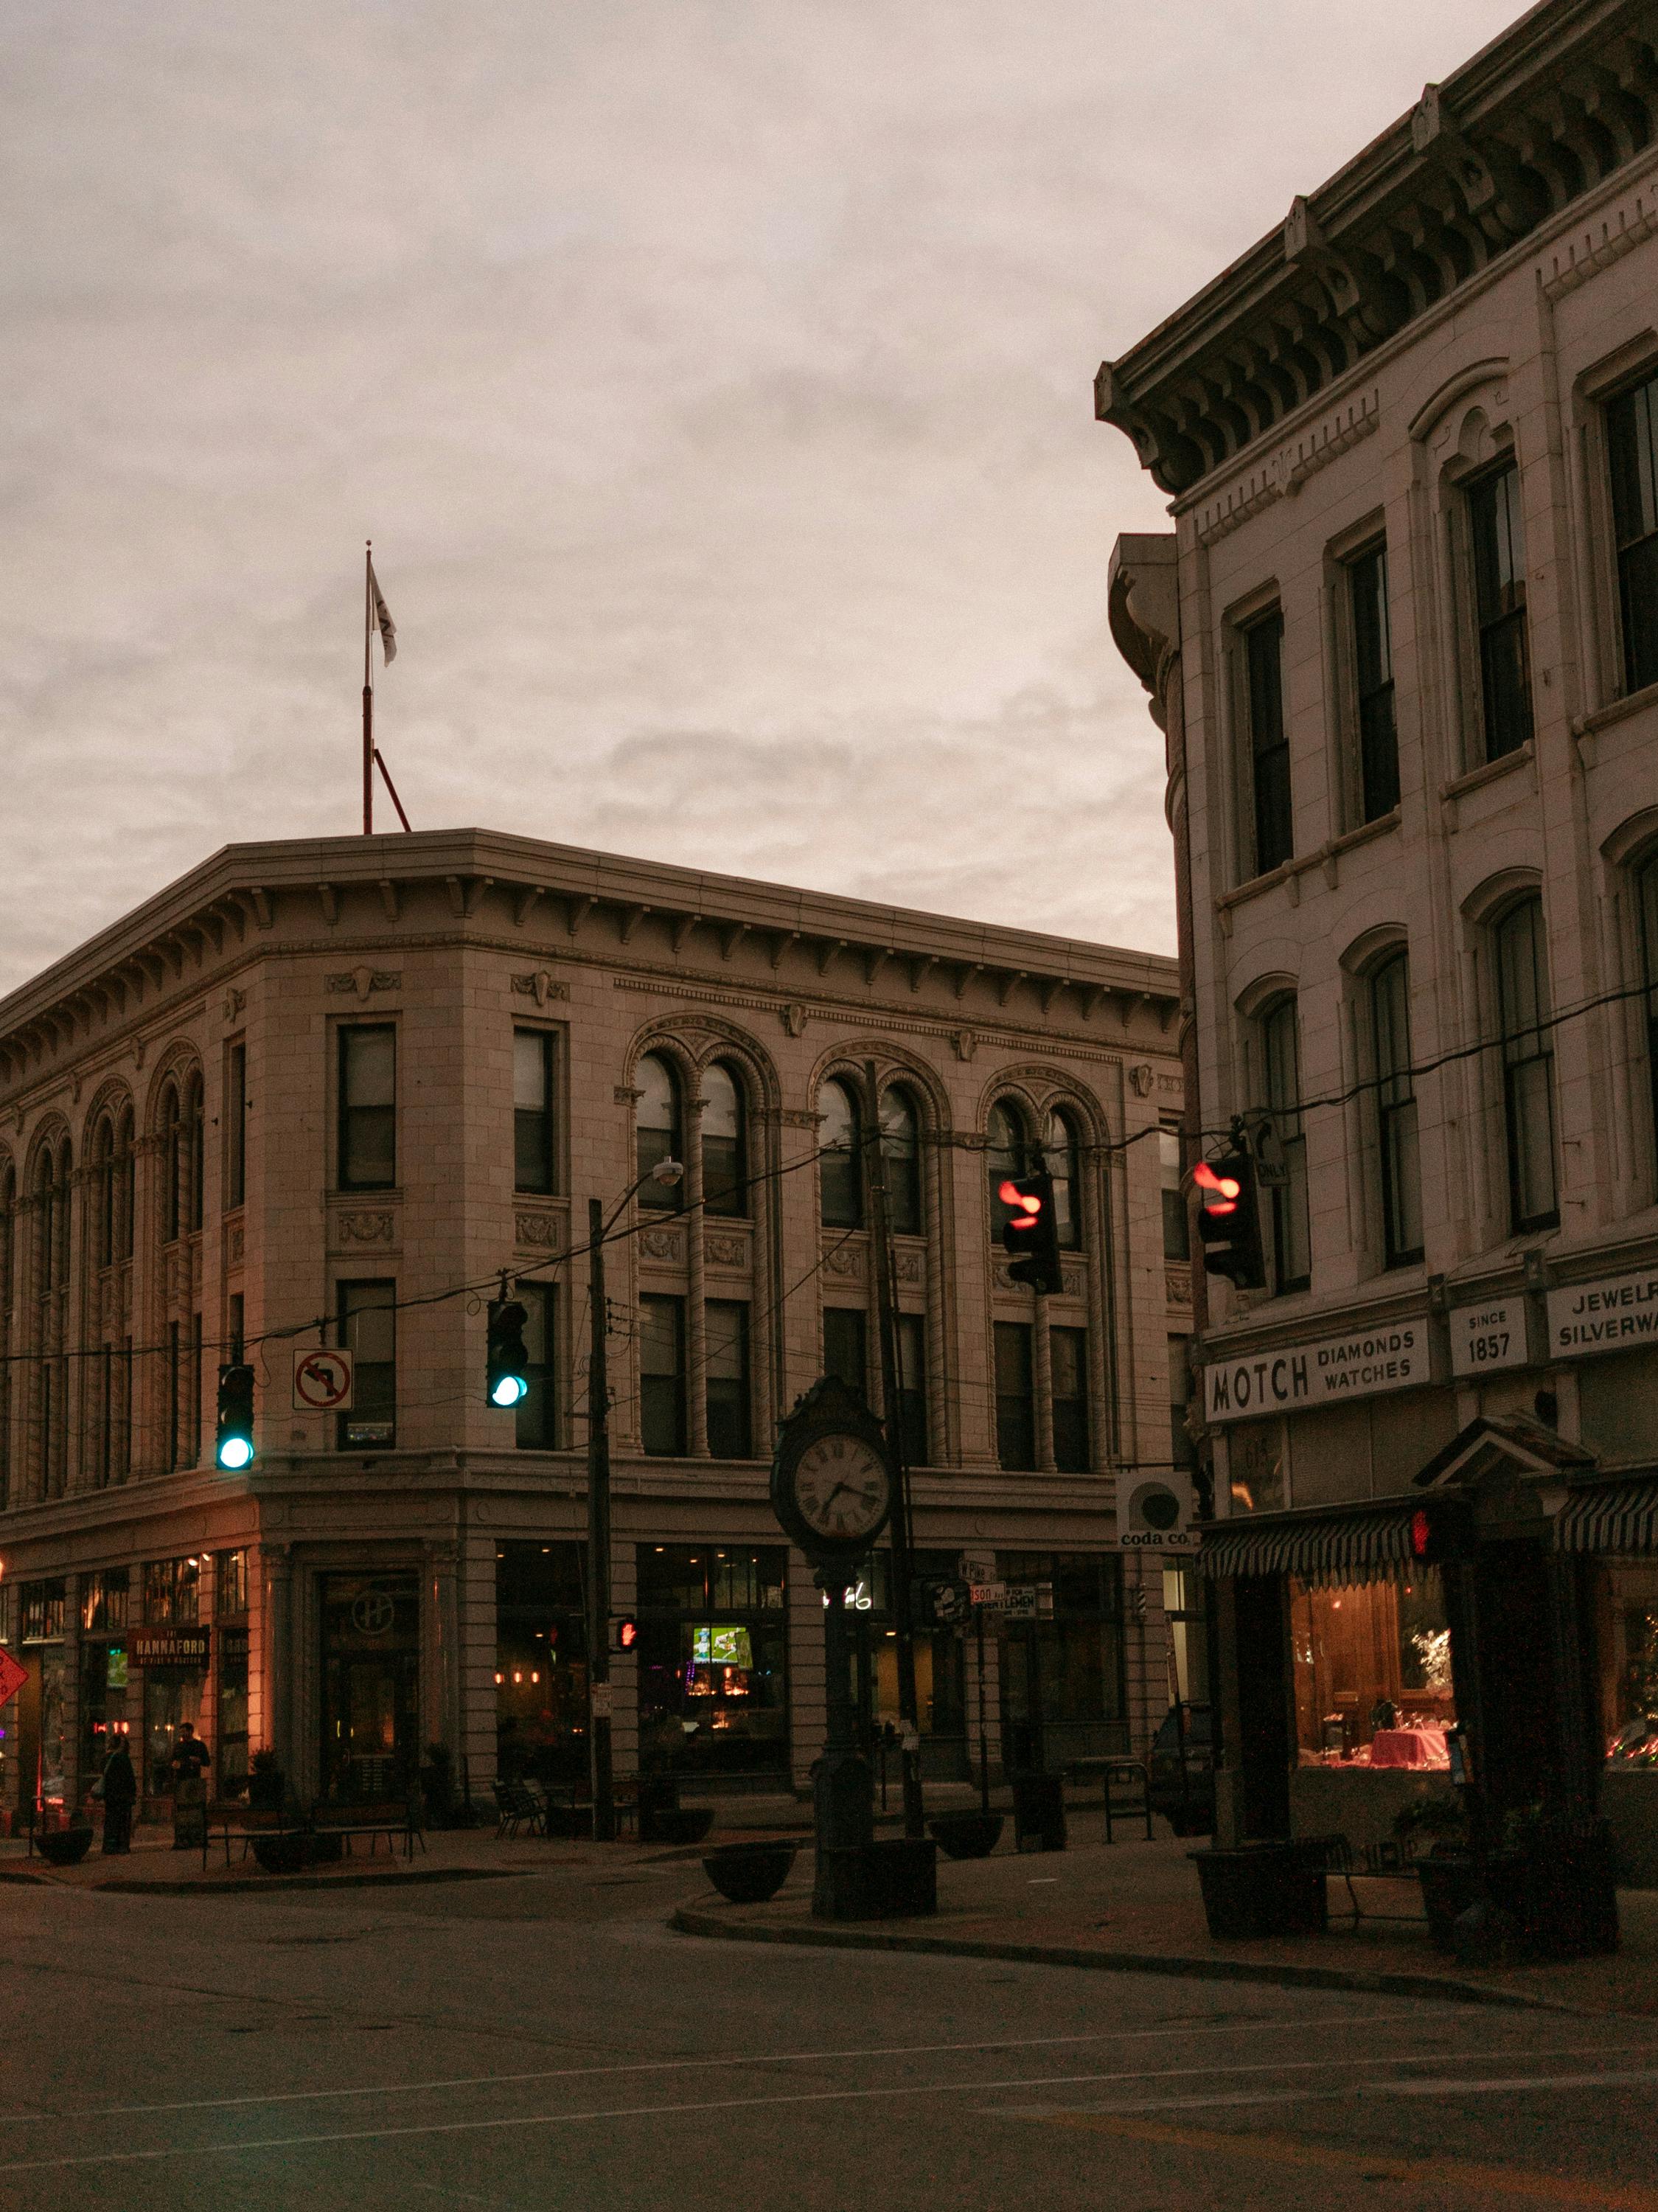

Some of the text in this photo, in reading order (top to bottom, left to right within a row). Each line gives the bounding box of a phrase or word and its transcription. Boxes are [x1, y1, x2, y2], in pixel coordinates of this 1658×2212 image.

[1469, 1310, 1507, 1329] SINCE
[1317, 1330, 1414, 1367] DIAMONDS
[1469, 1332, 1510, 1363] 1857
[1213, 1354, 1309, 1412] MOTCH
[1325, 1358, 1411, 1391] WATCHES
[1121, 1531, 1163, 1545] coda
[136, 1639, 206, 1655] HANNAFORD
